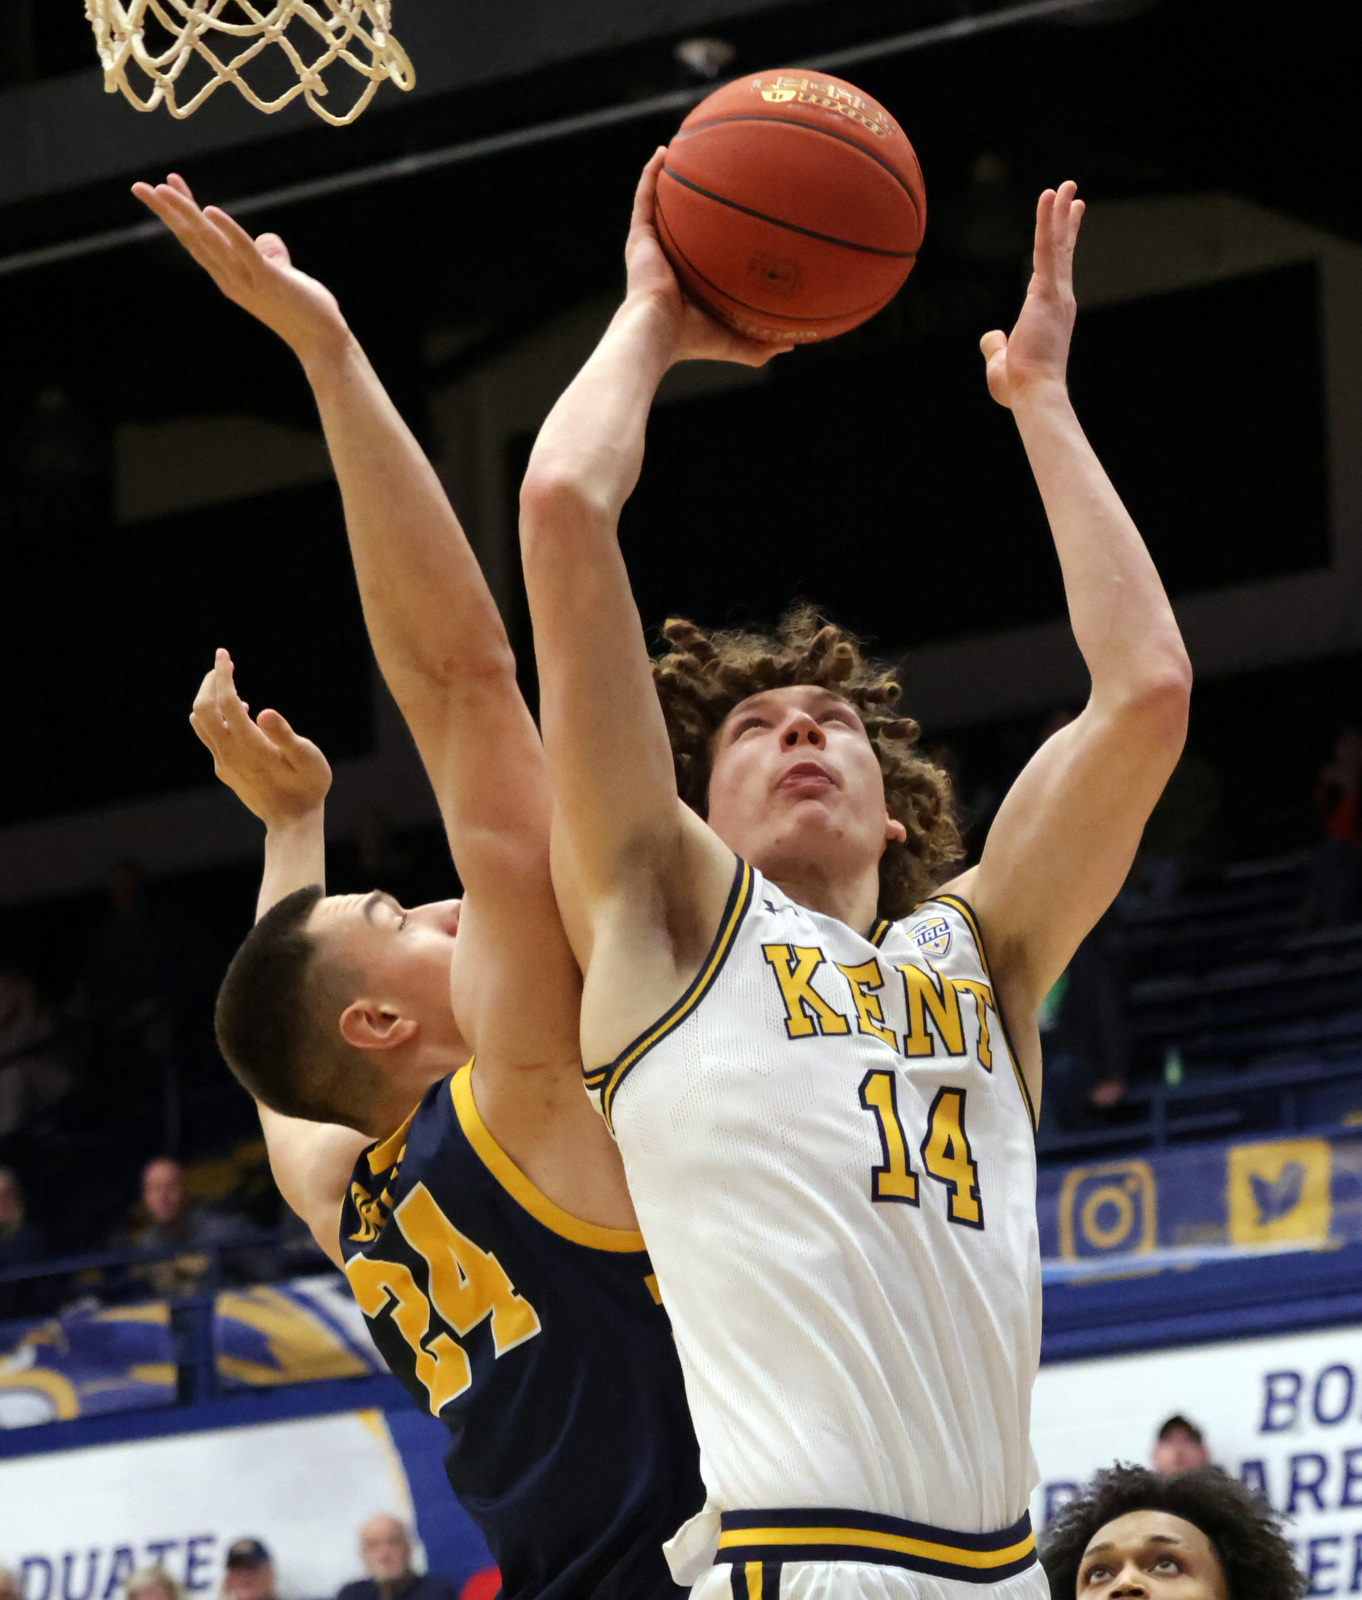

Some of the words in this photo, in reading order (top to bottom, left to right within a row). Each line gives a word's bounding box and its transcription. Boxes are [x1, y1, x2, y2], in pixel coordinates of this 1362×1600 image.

[761, 943, 995, 1074] KENT
[859, 1069, 985, 1231] 14
[345, 1181, 542, 1418] 24
[1260, 1364, 1362, 1433] BO
